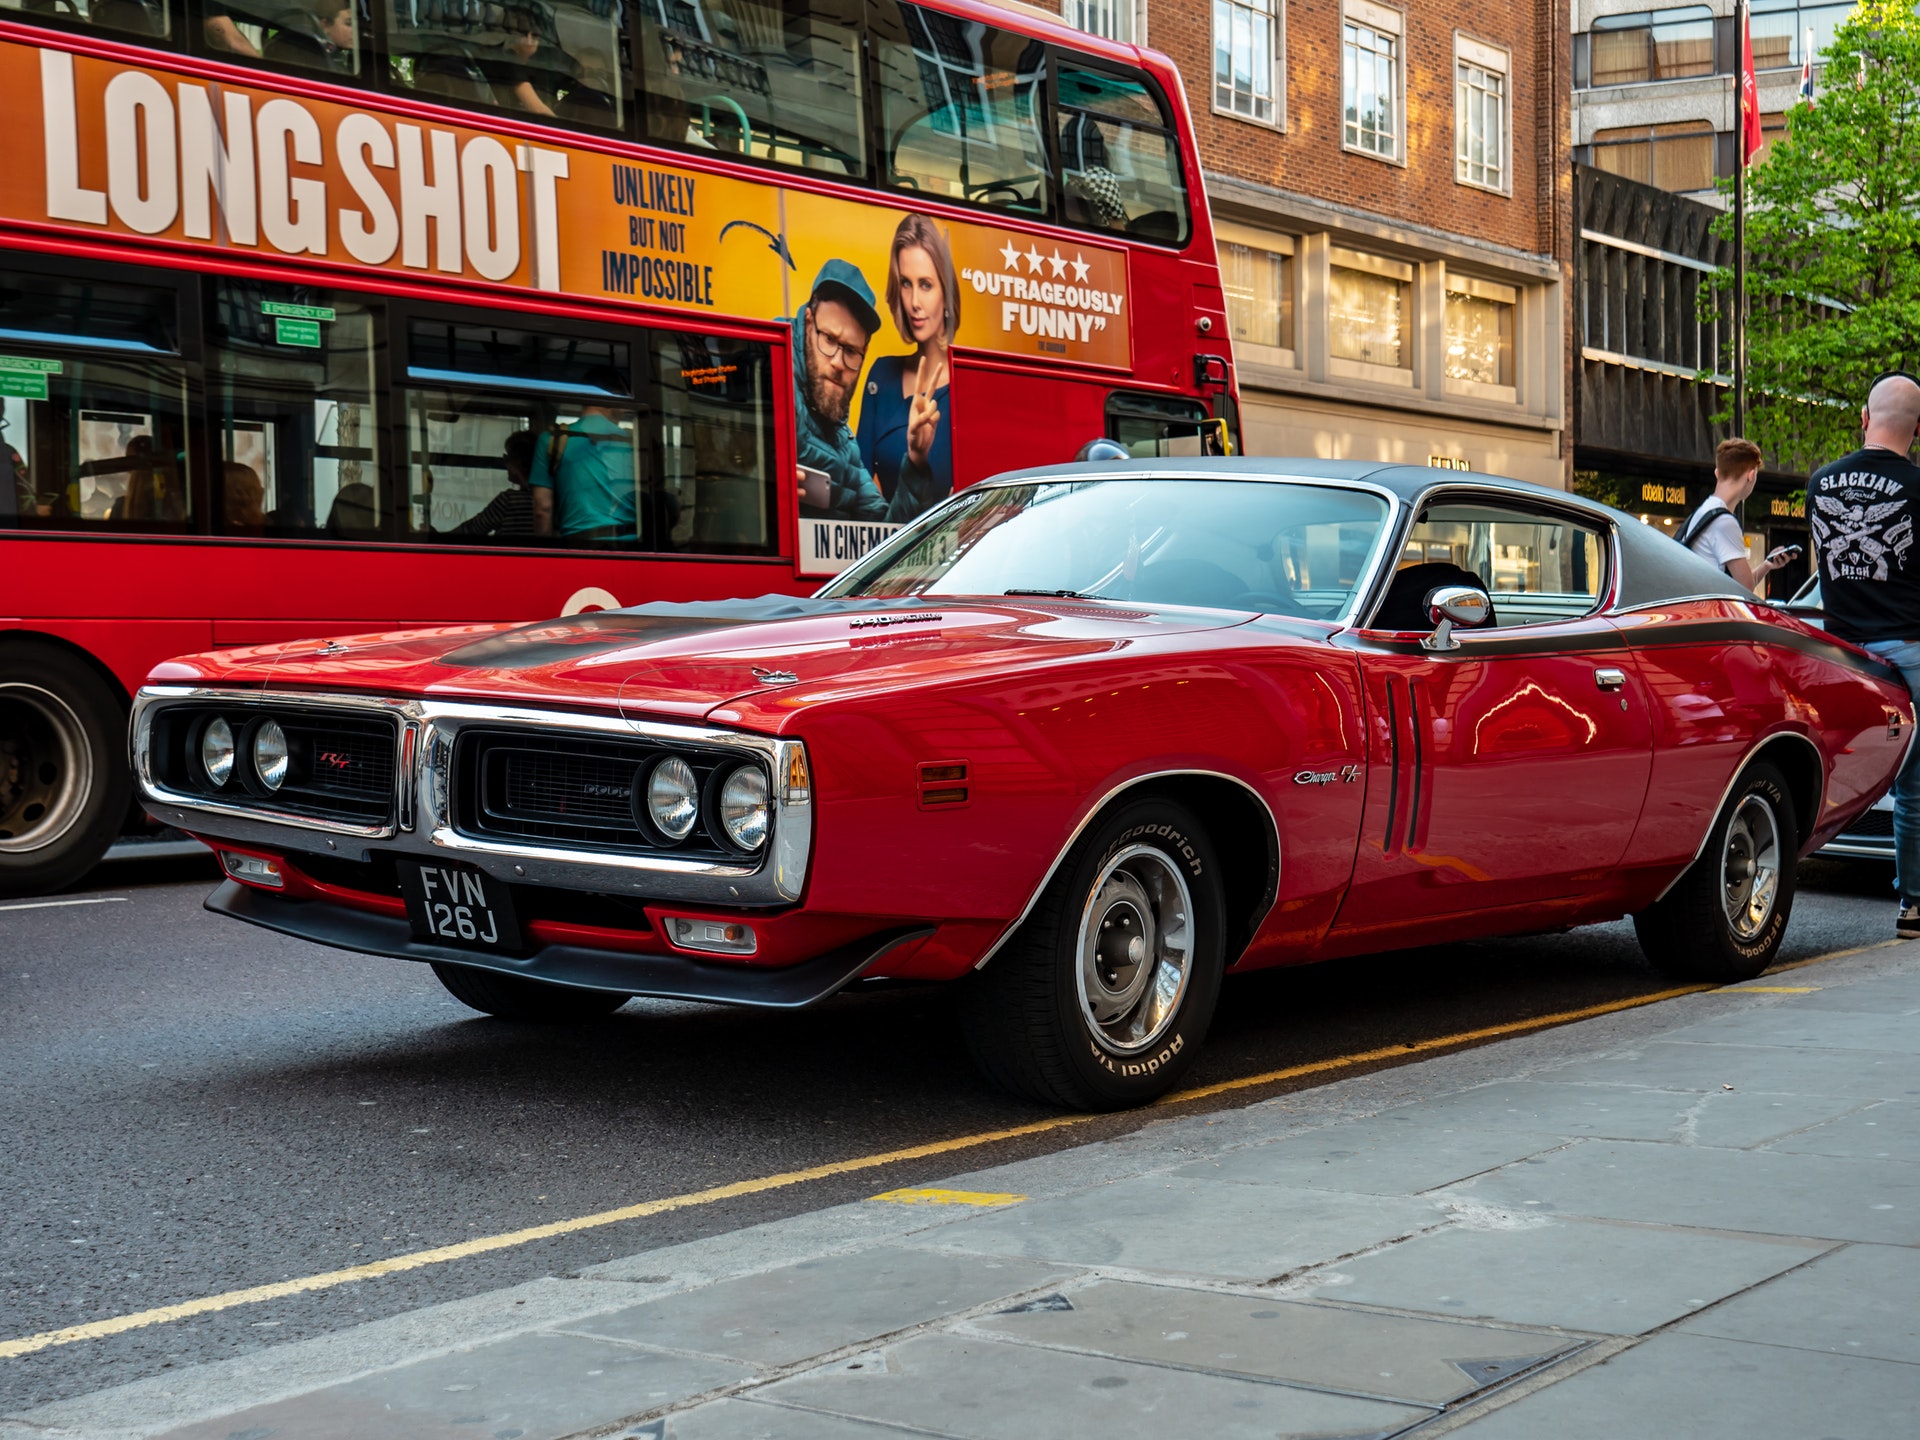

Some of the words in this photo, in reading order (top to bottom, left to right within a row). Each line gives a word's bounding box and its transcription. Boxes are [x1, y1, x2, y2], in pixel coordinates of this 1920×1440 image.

[40, 48, 327, 256] LONG
[336, 113, 569, 293] SHOT
[612, 164, 695, 217] UNLIKELY
[629, 215, 655, 249] BUT
[659, 220, 685, 254] NOT
[602, 250, 714, 306] IMPOSSIBLE
[1820, 471, 1904, 497] SLACKJAW
[814, 523, 830, 559] IN
[835, 525, 899, 560] CINEM
[1841, 563, 1870, 578] HIGH
[320, 752, 350, 769] R/T
[1294, 770, 1338, 786] Charger
[420, 866, 486, 908] FVN
[424, 901, 498, 943] 126J
[1121, 1033, 1185, 1077] Radial
